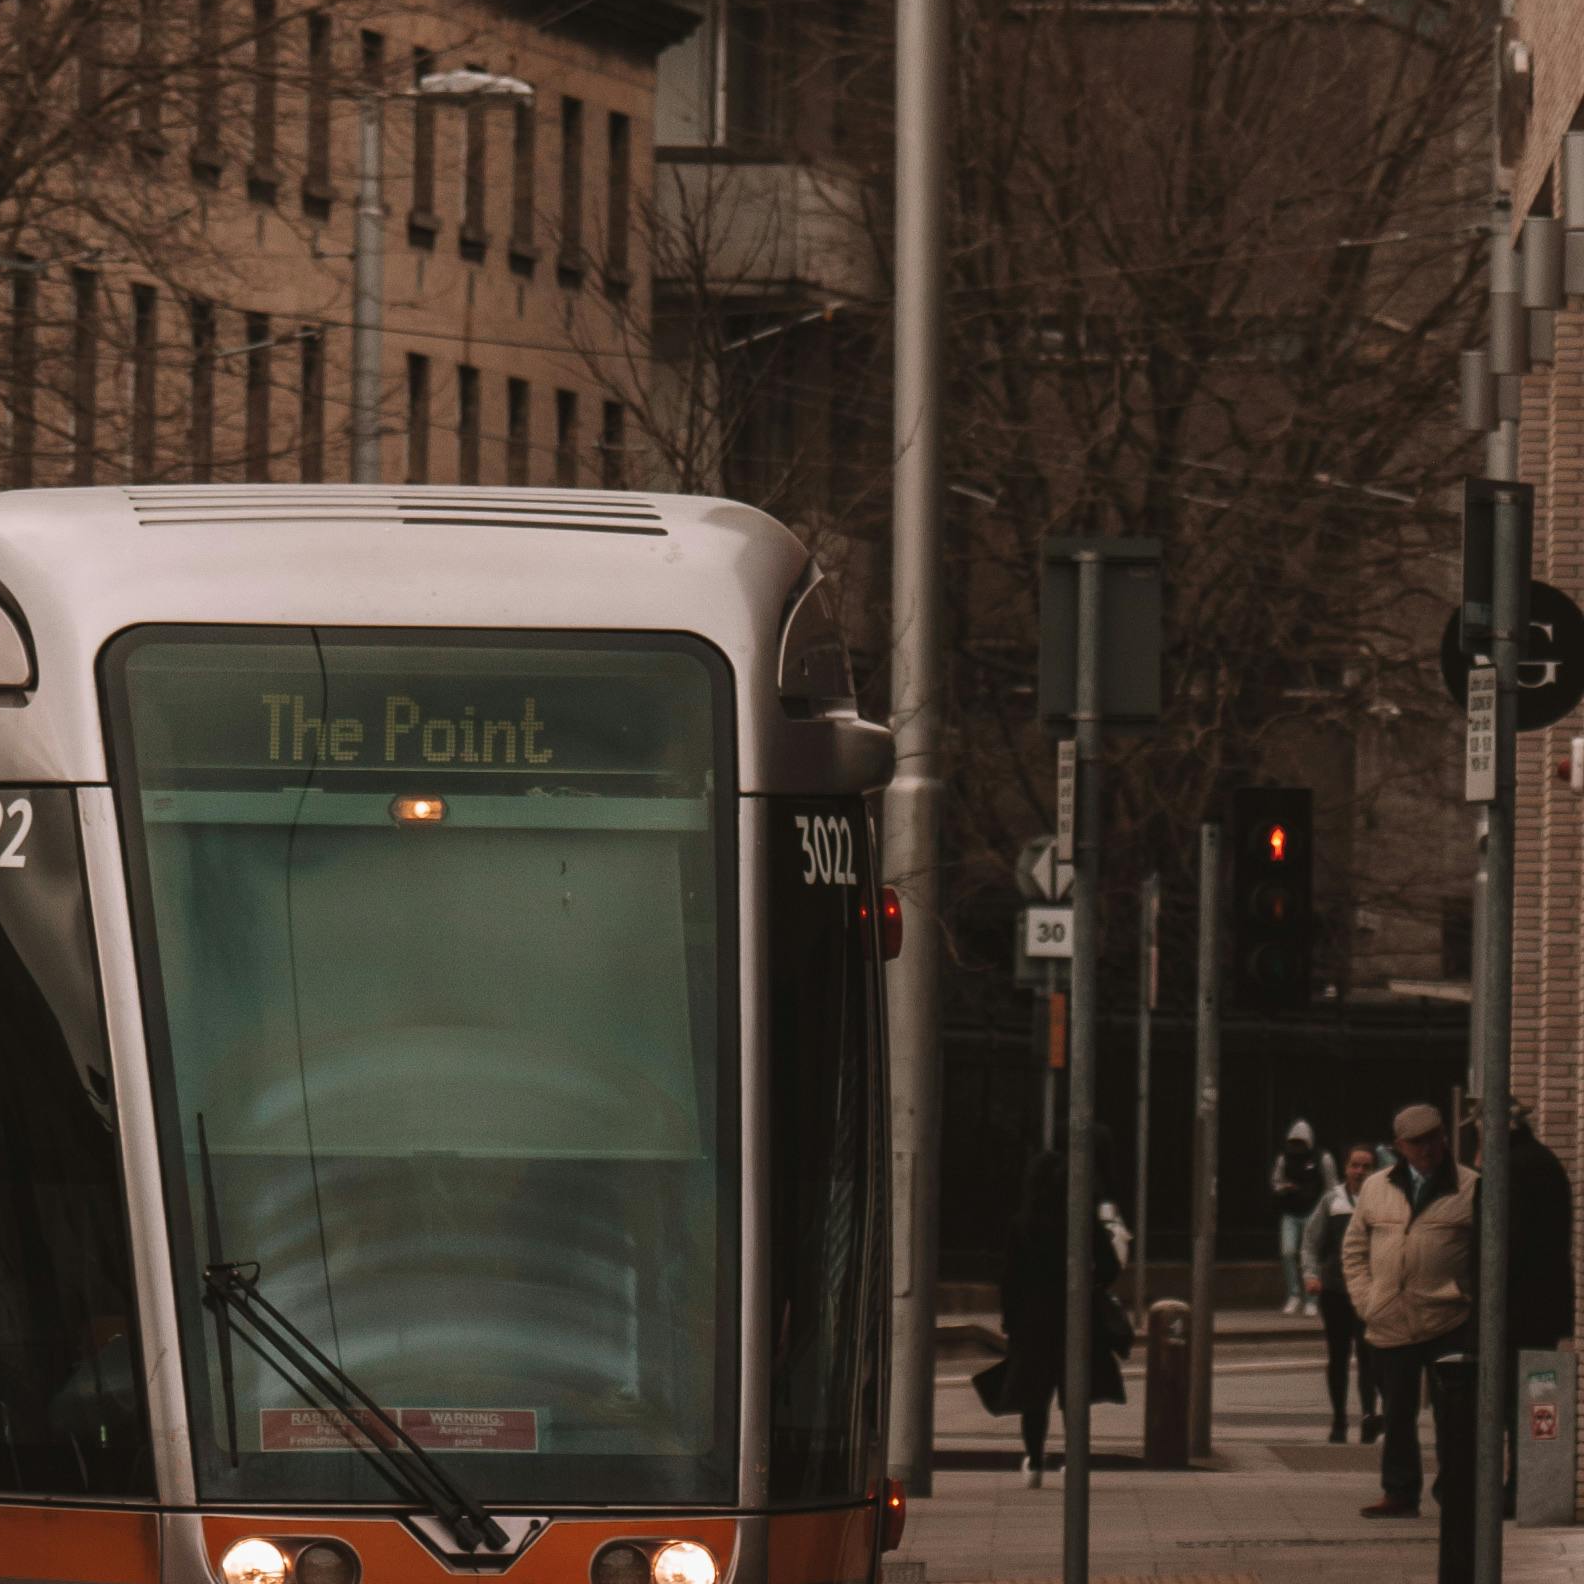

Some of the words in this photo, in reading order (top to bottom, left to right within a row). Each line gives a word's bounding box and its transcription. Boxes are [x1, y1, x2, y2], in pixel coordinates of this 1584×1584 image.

[262, 694, 365, 761] The
[384, 695, 554, 763] Point
[795, 815, 857, 886] 3022
[1036, 922, 1066, 944] 30
